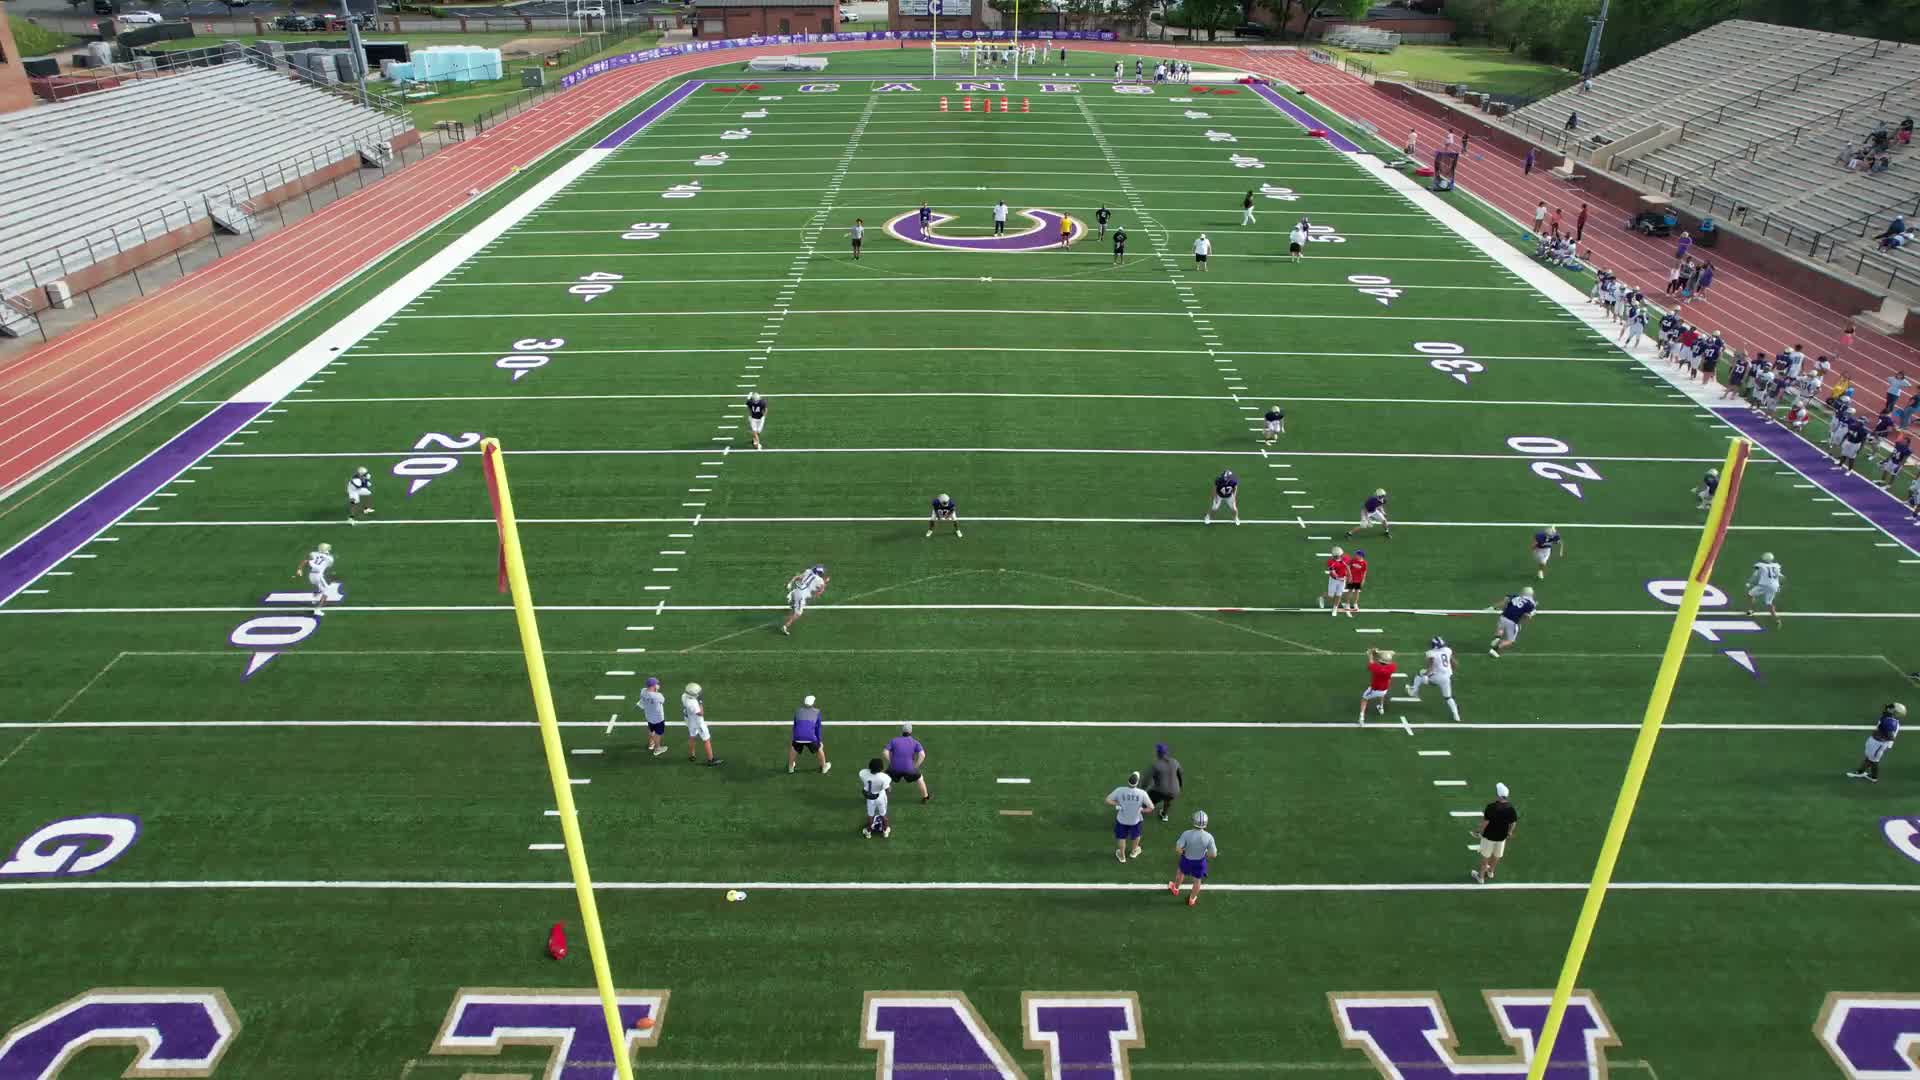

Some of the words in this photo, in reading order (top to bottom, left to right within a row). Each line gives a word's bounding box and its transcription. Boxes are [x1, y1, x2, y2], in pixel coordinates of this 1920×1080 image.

[620, 221, 671, 240] 50
[567, 271, 624, 295] 40
[1347, 274, 1402, 298] 40
[495, 337, 566, 370] 30
[1412, 341, 1485, 373] 30
[392, 431, 482, 476] 20
[1505, 435, 1603, 482] 20
[1220, 486, 1233, 496] 47
[228, 582, 345, 646] 10
[1646, 578, 1762, 642] 10
[867, 780, 873, 793] 1
[0, 815, 140, 875] G
